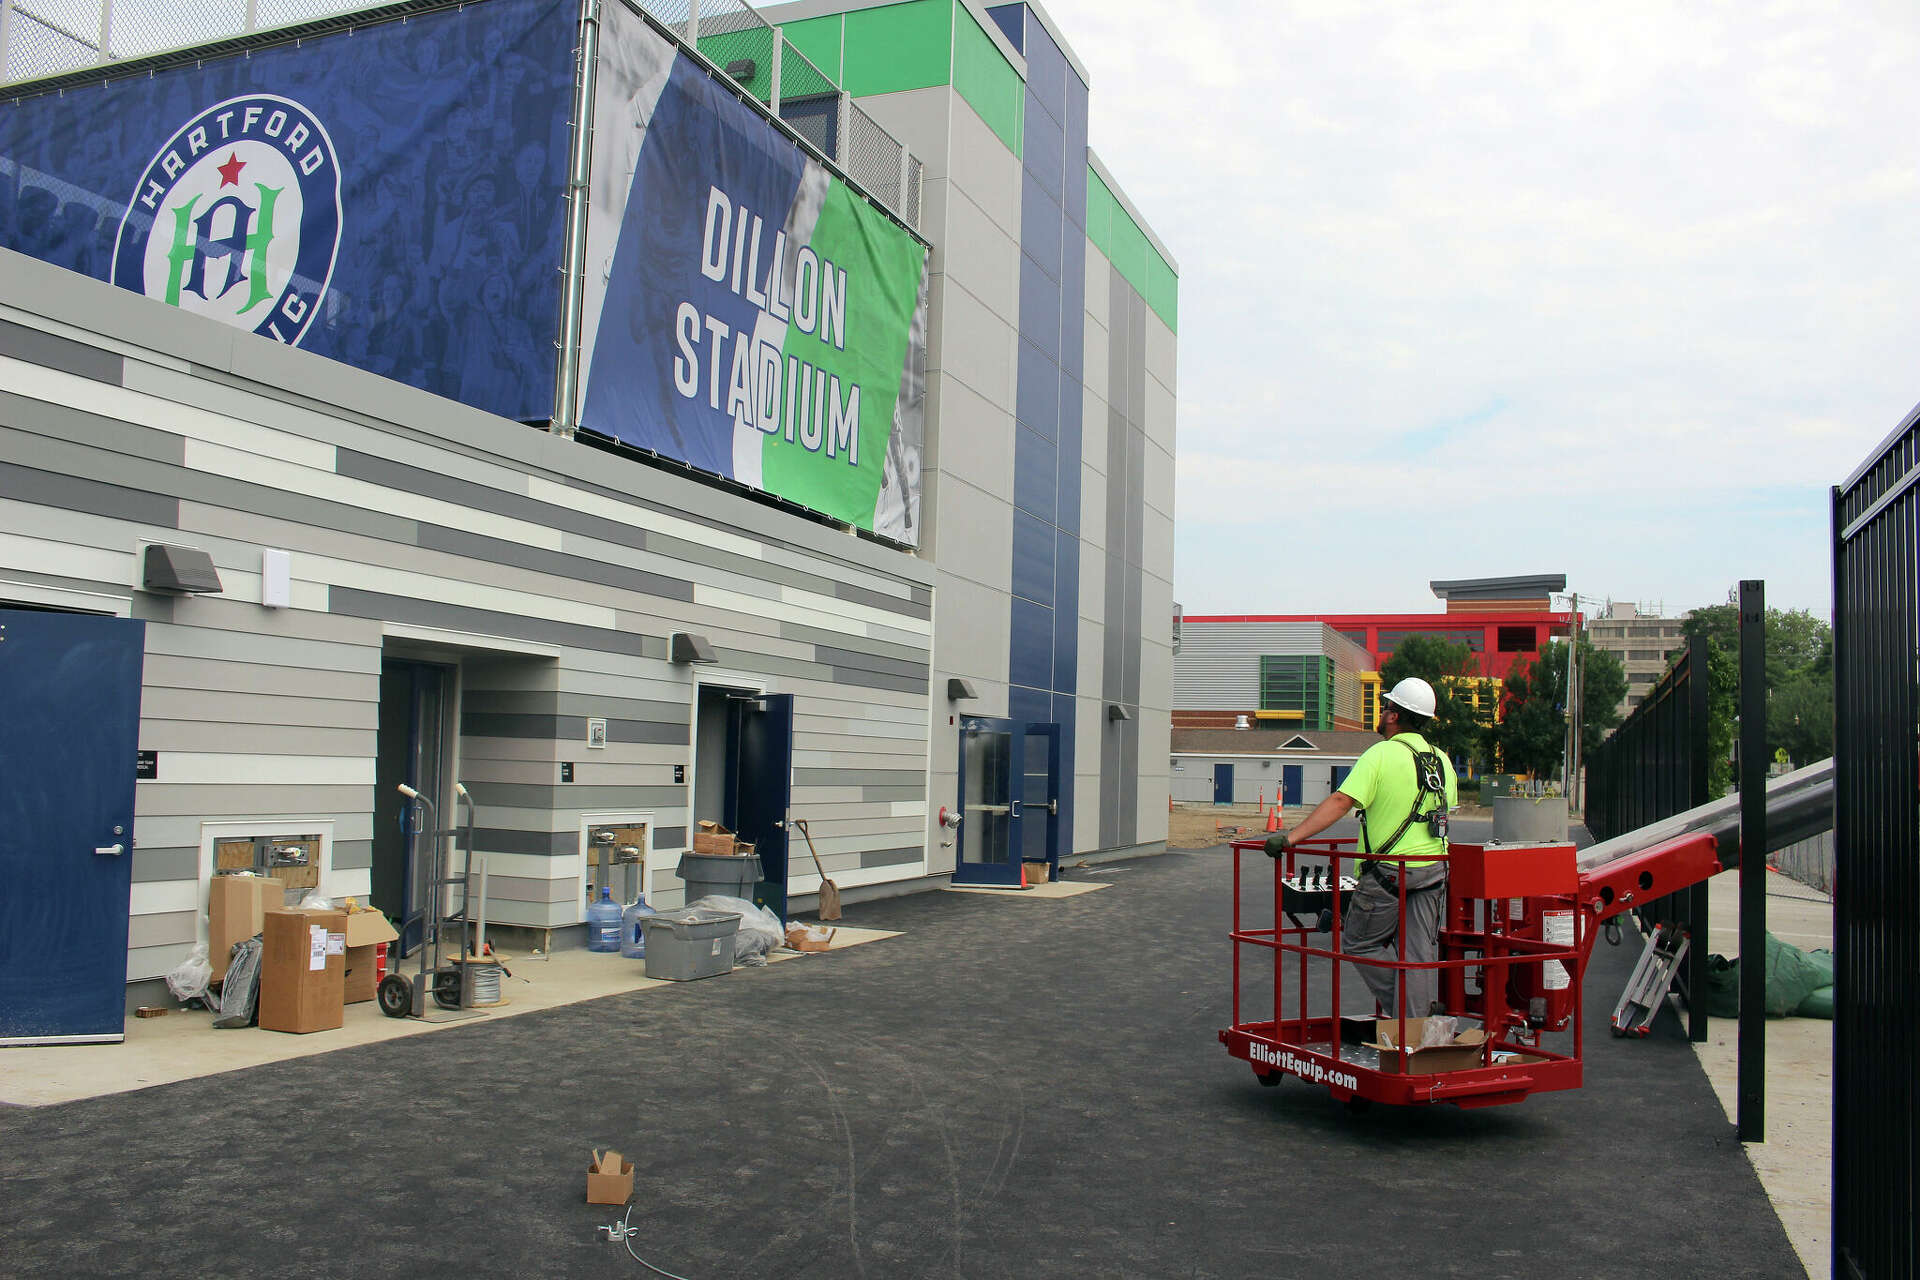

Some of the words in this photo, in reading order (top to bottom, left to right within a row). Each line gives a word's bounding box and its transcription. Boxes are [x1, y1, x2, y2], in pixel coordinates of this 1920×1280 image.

[141, 107, 324, 209] HARTFORD
[701, 185, 848, 352] DILLON
[673, 301, 861, 467] STADIUM
[1249, 1041, 1358, 1091] ElliottEquip.com
